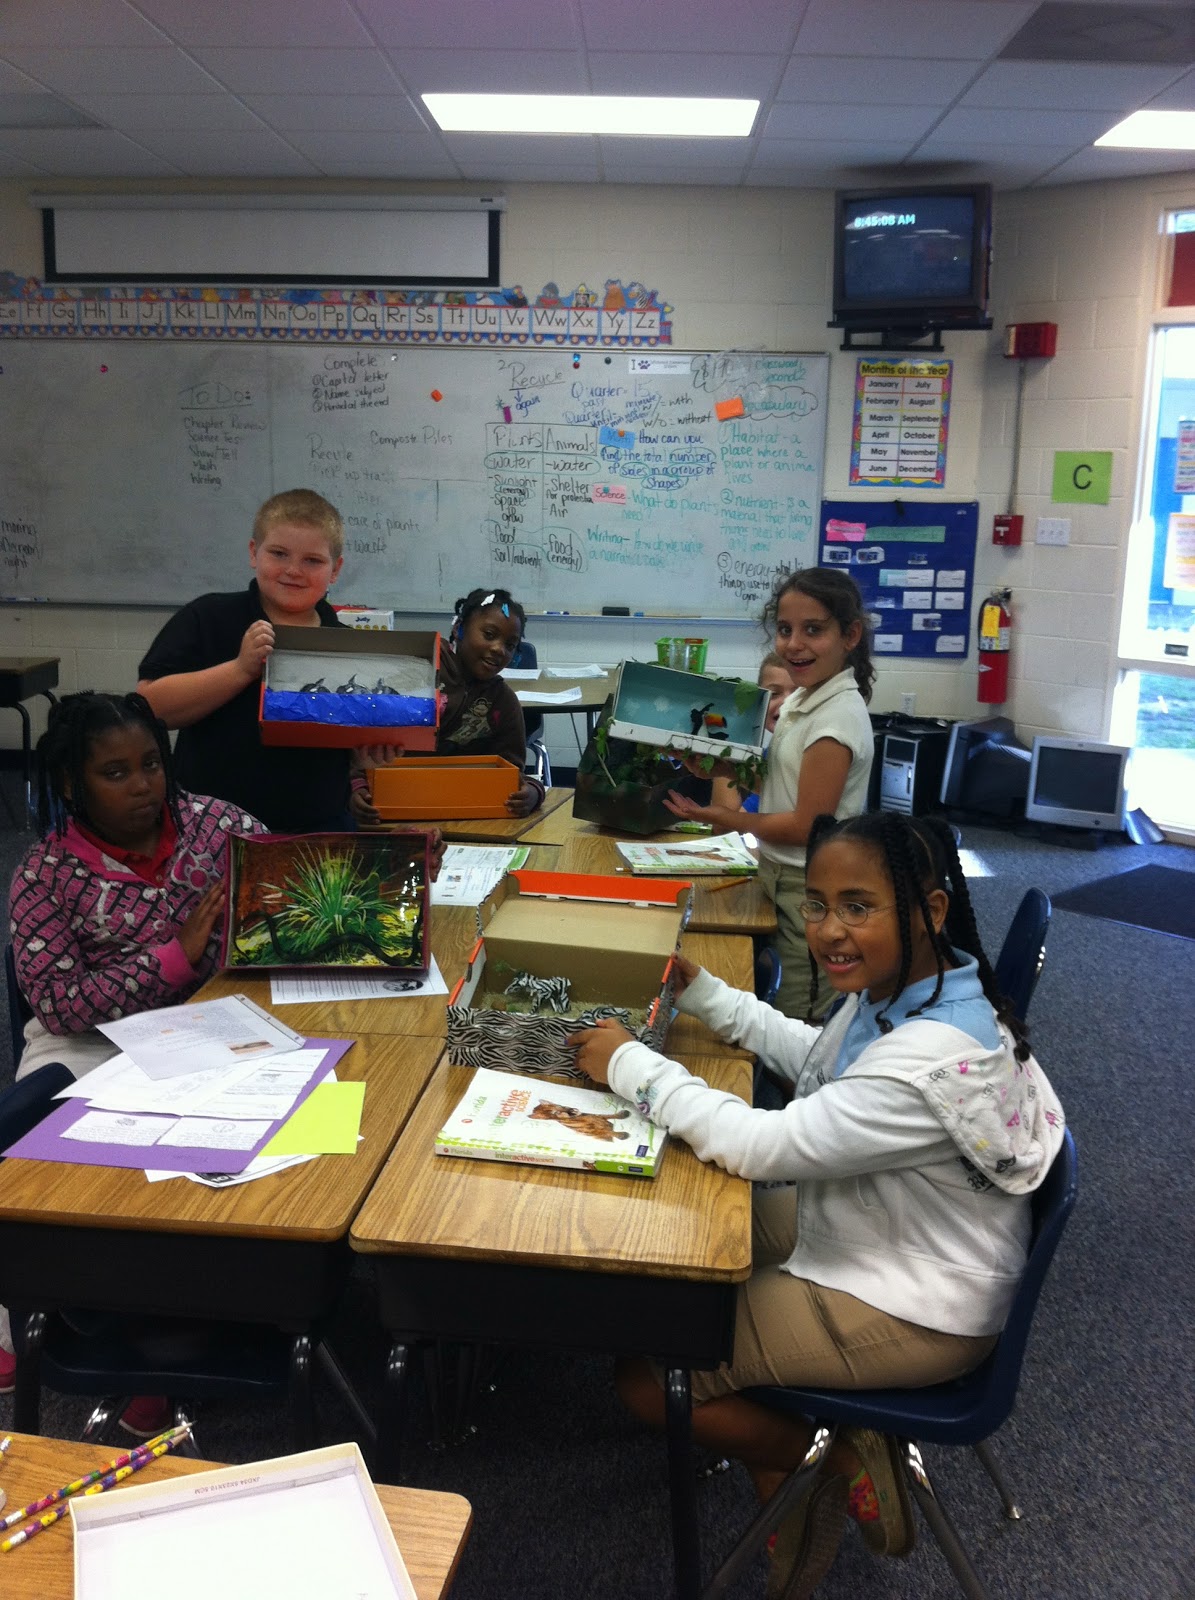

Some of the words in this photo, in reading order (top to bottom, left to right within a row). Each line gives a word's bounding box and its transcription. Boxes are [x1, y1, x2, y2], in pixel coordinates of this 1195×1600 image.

[898, 214, 916, 225] AM
[84, 301, 106, 318] Hh
[226, 304, 256, 319] Mm
[263, 304, 286, 319] Nn
[293, 305, 316, 320] Oo
[323, 305, 344, 329] Pp
[353, 306, 380, 330] Qq
[387, 306, 407, 322] Rr
[415, 307, 434, 323] Ss
[447, 308, 464, 324] Tt
[475, 309, 496, 325] Uu
[506, 309, 524, 325] Vv
[534, 310, 567, 326] Ww
[573, 311, 594, 327] Xx
[606, 312, 624, 335] Yy
[636, 312, 655, 328] Zz
[324, 352, 378, 374] Complete
[631, 359, 636, 370] I
[508, 361, 564, 389] Recycle
[862, 365, 895, 374] Months
[898, 366, 907, 374] of
[927, 366, 948, 375] Year
[322, 373, 357, 388] Capital
[364, 371, 389, 383] letter
[868, 380, 899, 389] January
[915, 381, 931, 390] July
[669, 393, 693, 407] with
[865, 397, 899, 406] February
[909, 398, 936, 407] August
[515, 396, 541, 418] again
[869, 414, 894, 422] March
[903, 415, 939, 423] September
[546, 427, 597, 451] Animals
[732, 424, 779, 444] Habitat
[871, 431, 890, 440] April
[903, 432, 936, 440] October
[639, 428, 659, 444] How
[684, 435, 703, 454] you
[669, 447, 711, 461] number
[721, 444, 753, 460] place
[757, 446, 789, 458] where
[870, 448, 888, 457] May
[901, 449, 937, 457] November
[869, 465, 888, 473] June
[899, 465, 936, 473] December
[1073, 464, 1093, 490] C
[550, 474, 590, 495] Shelter
[595, 487, 626, 500] Science
[550, 503, 568, 518] Air
